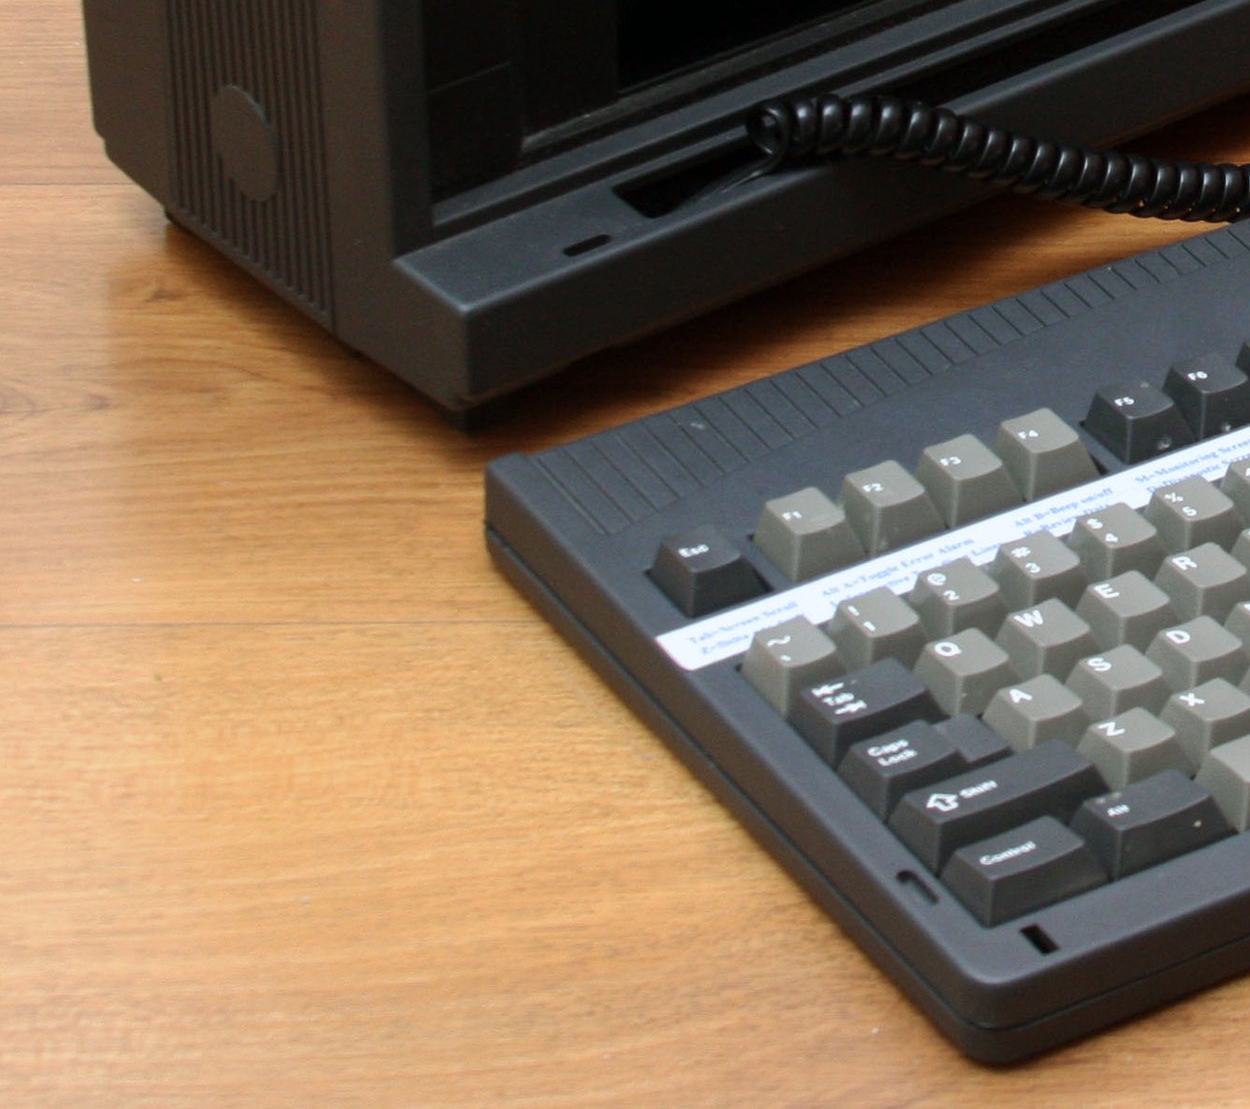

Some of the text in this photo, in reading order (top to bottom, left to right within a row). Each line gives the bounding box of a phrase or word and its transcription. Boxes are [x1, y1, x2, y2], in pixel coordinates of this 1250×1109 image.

[1187, 371, 1208, 381] F6
[1114, 396, 1135, 407] F5
[1017, 429, 1039, 440] F4
[939, 456, 962, 467] F3
[862, 483, 883, 493] F2
[781, 511, 802, 521] F1
[1171, 556, 1198, 571] R
[1093, 583, 1120, 599] E
[1013, 609, 1044, 628] W
[1165, 630, 1191, 644] D
[934, 642, 962, 657] Q
[1087, 657, 1112, 672] S
[1009, 688, 1033, 704] A
[1179, 692, 1205, 707] X
[1097, 721, 1125, 737] Z
[867, 739, 909, 757] Caps
[877, 749, 918, 767] Lock
[959, 779, 998, 799] Shift
[979, 841, 1036, 866] Control
